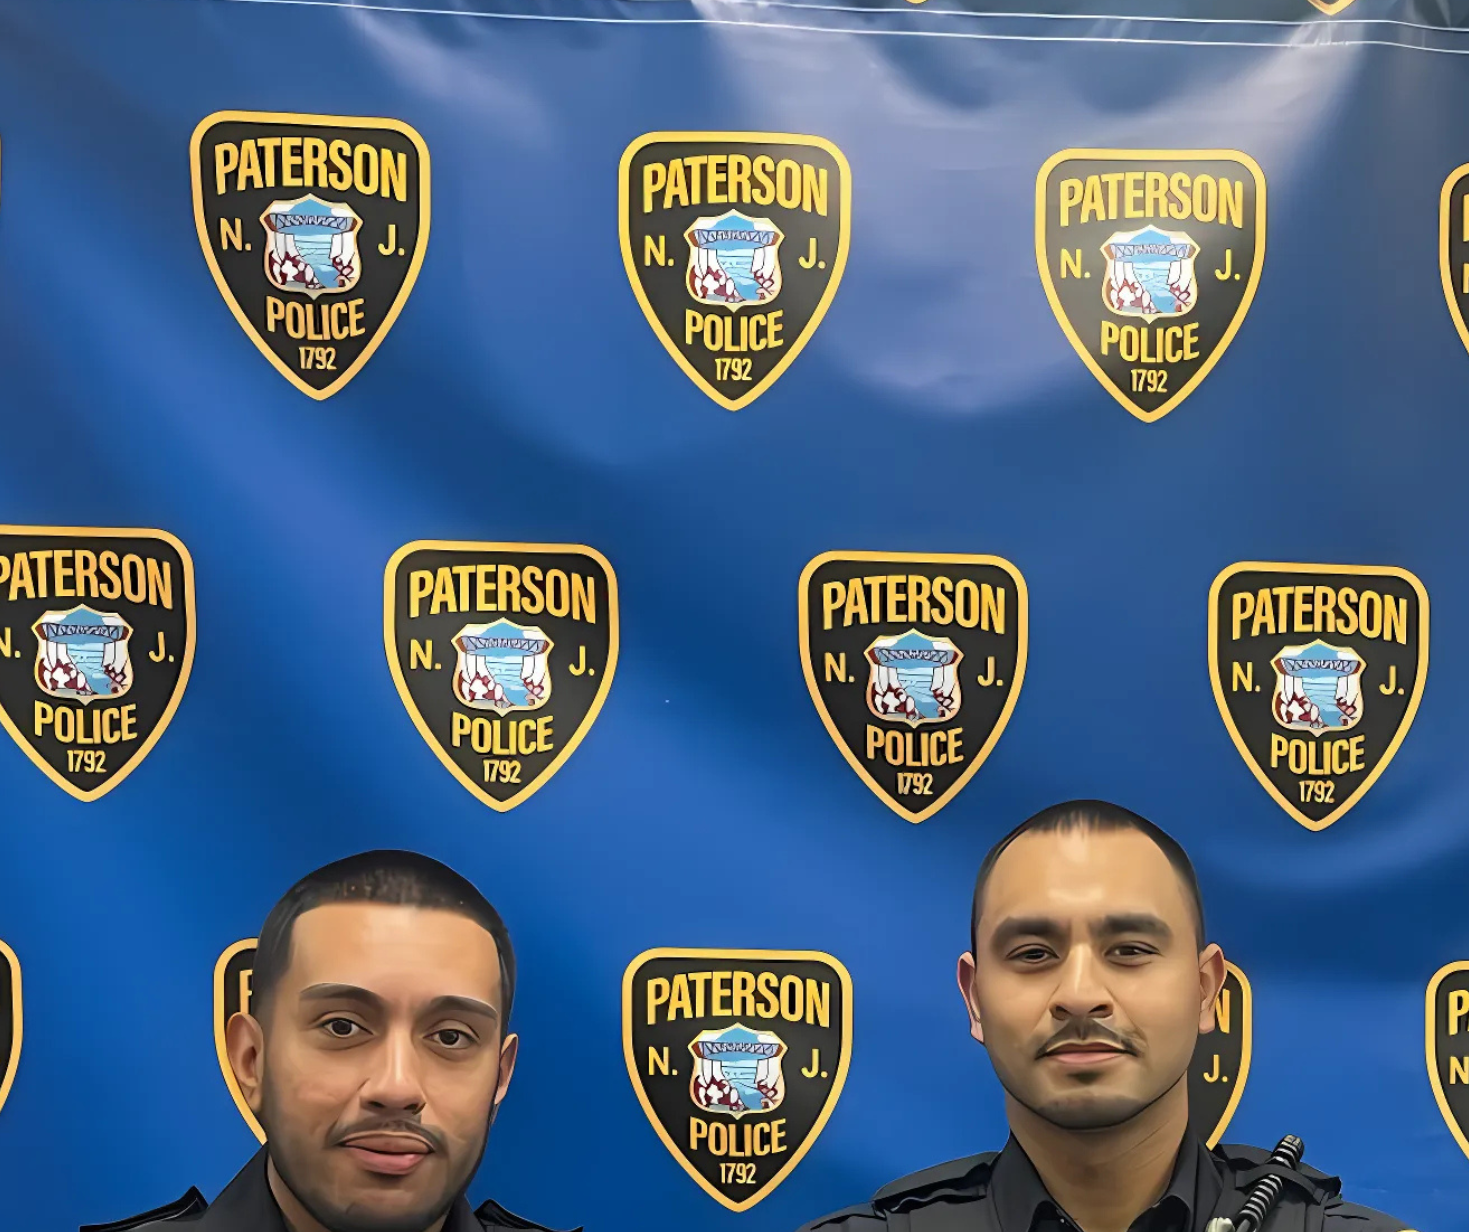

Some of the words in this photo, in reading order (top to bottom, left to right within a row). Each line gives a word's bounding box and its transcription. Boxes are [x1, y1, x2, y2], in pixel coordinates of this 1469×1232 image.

[214, 136, 407, 202] PATERSON
[643, 153, 829, 216] PATERSON
[1059, 171, 1244, 228] PATERSON
[220, 218, 251, 250] N.
[378, 224, 404, 256] J.
[644, 235, 674, 266] N.
[798, 238, 826, 269] J.
[1060, 248, 1090, 279] N.
[1215, 249, 1241, 281] J.
[266, 295, 366, 341] POLICE
[685, 309, 784, 352] POLICE
[299, 346, 336, 370] 1792
[1100, 320, 1200, 364] POLICE
[715, 357, 753, 381] 1792
[1131, 368, 1168, 393] 1792
[409, 564, 596, 624] PATERSON
[822, 574, 1006, 634] PATERSON
[1232, 585, 1408, 645] PATERSON
[149, 632, 174, 662] J.
[410, 639, 441, 670] N.
[569, 646, 595, 676] J.
[825, 652, 854, 682] N.
[978, 656, 1003, 686] J.
[1233, 662, 1260, 692] N.
[1379, 665, 1404, 695] J.
[34, 700, 138, 744] POLICE
[452, 711, 554, 755] POLICE
[67, 750, 107, 773] 1792
[866, 724, 964, 767] POLICE
[1270, 733, 1365, 776] POLICE
[483, 759, 522, 783] 1792
[897, 772, 933, 795] 1792
[1299, 780, 1335, 803] 1792
[647, 970, 830, 1028] PATERSON
[649, 1046, 677, 1075] N.
[801, 1049, 828, 1078] J.
[1203, 1054, 1229, 1083] J.
[689, 1117, 787, 1157] POLICE
[720, 1162, 756, 1184] 1792
